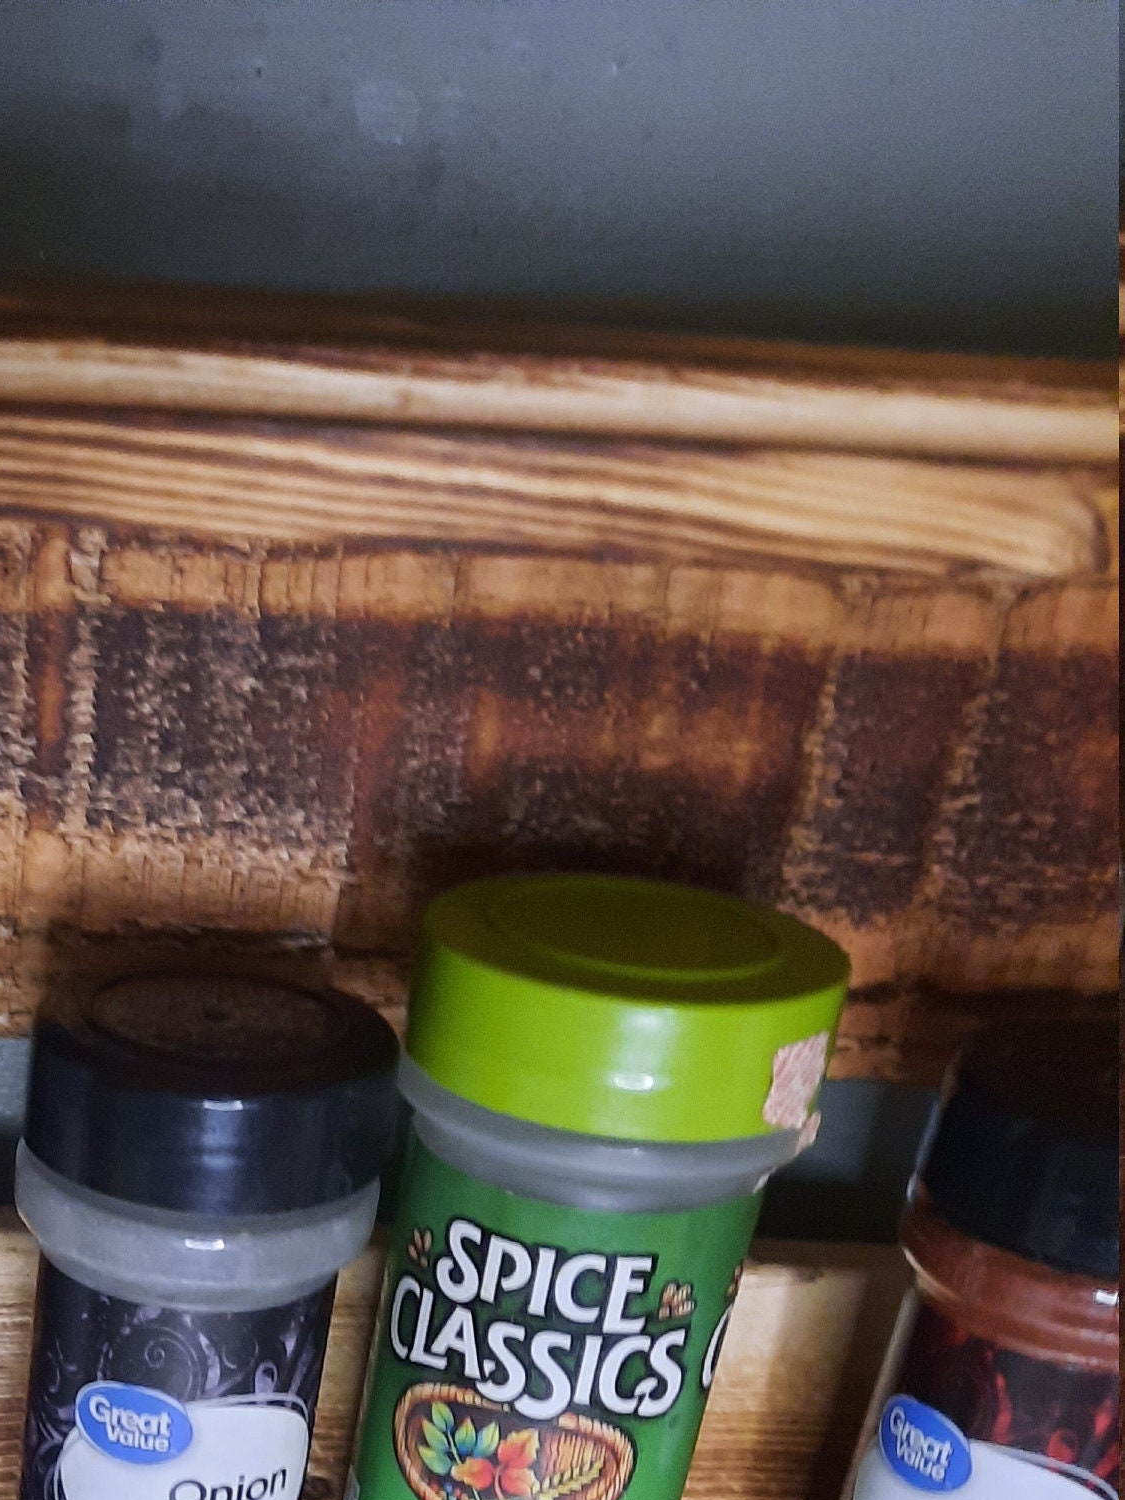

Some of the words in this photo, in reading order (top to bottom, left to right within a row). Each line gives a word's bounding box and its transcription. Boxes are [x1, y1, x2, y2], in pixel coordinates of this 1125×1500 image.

[436, 1219, 654, 1334] SPICE
[390, 1275, 686, 1420] CLASSICS
[89, 1394, 172, 1438] Great
[104, 1417, 171, 1453] Value
[890, 1406, 953, 1469] Great
[897, 1432, 946, 1482] Value
